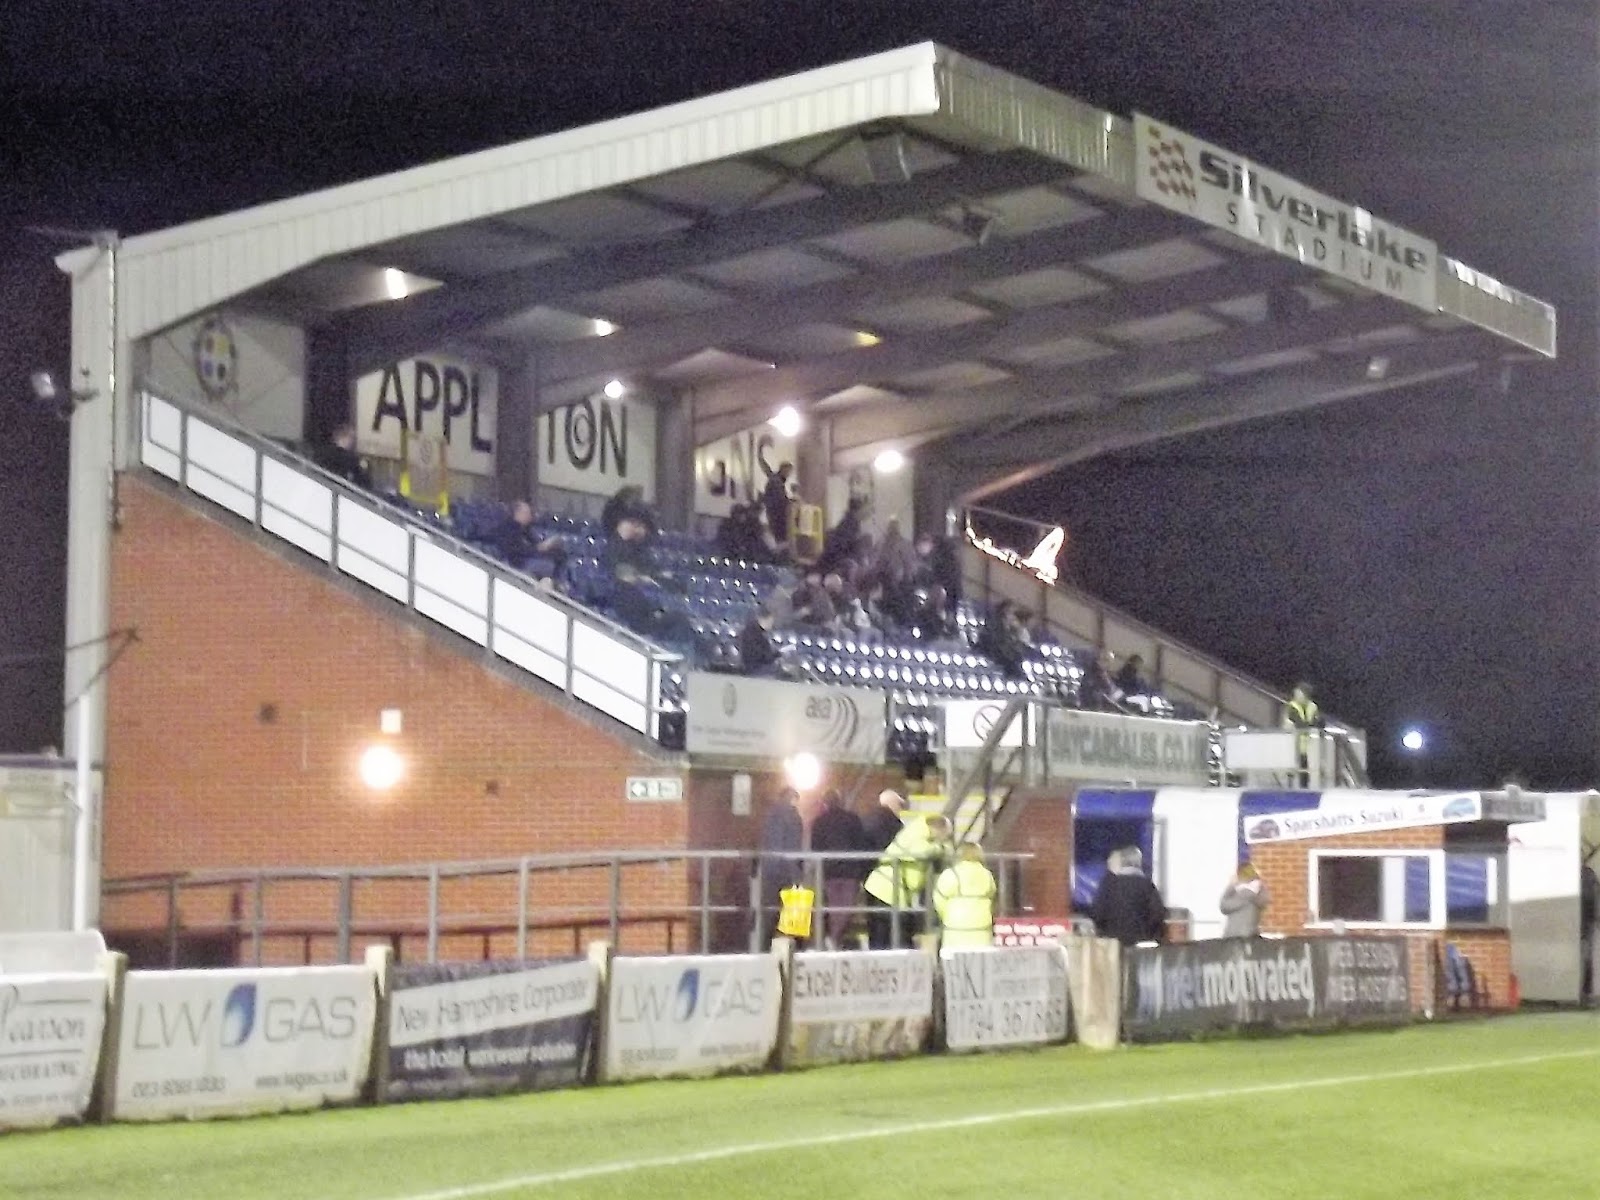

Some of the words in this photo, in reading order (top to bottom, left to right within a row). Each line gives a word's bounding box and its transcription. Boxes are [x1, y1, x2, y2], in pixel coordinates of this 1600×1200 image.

[1201, 150, 1427, 274] Silverlake
[1228, 202, 1400, 290] STADIUM
[1359, 806, 1404, 827] Suzuki
[134, 1001, 211, 1050] LW
[264, 996, 358, 1043] GAS
